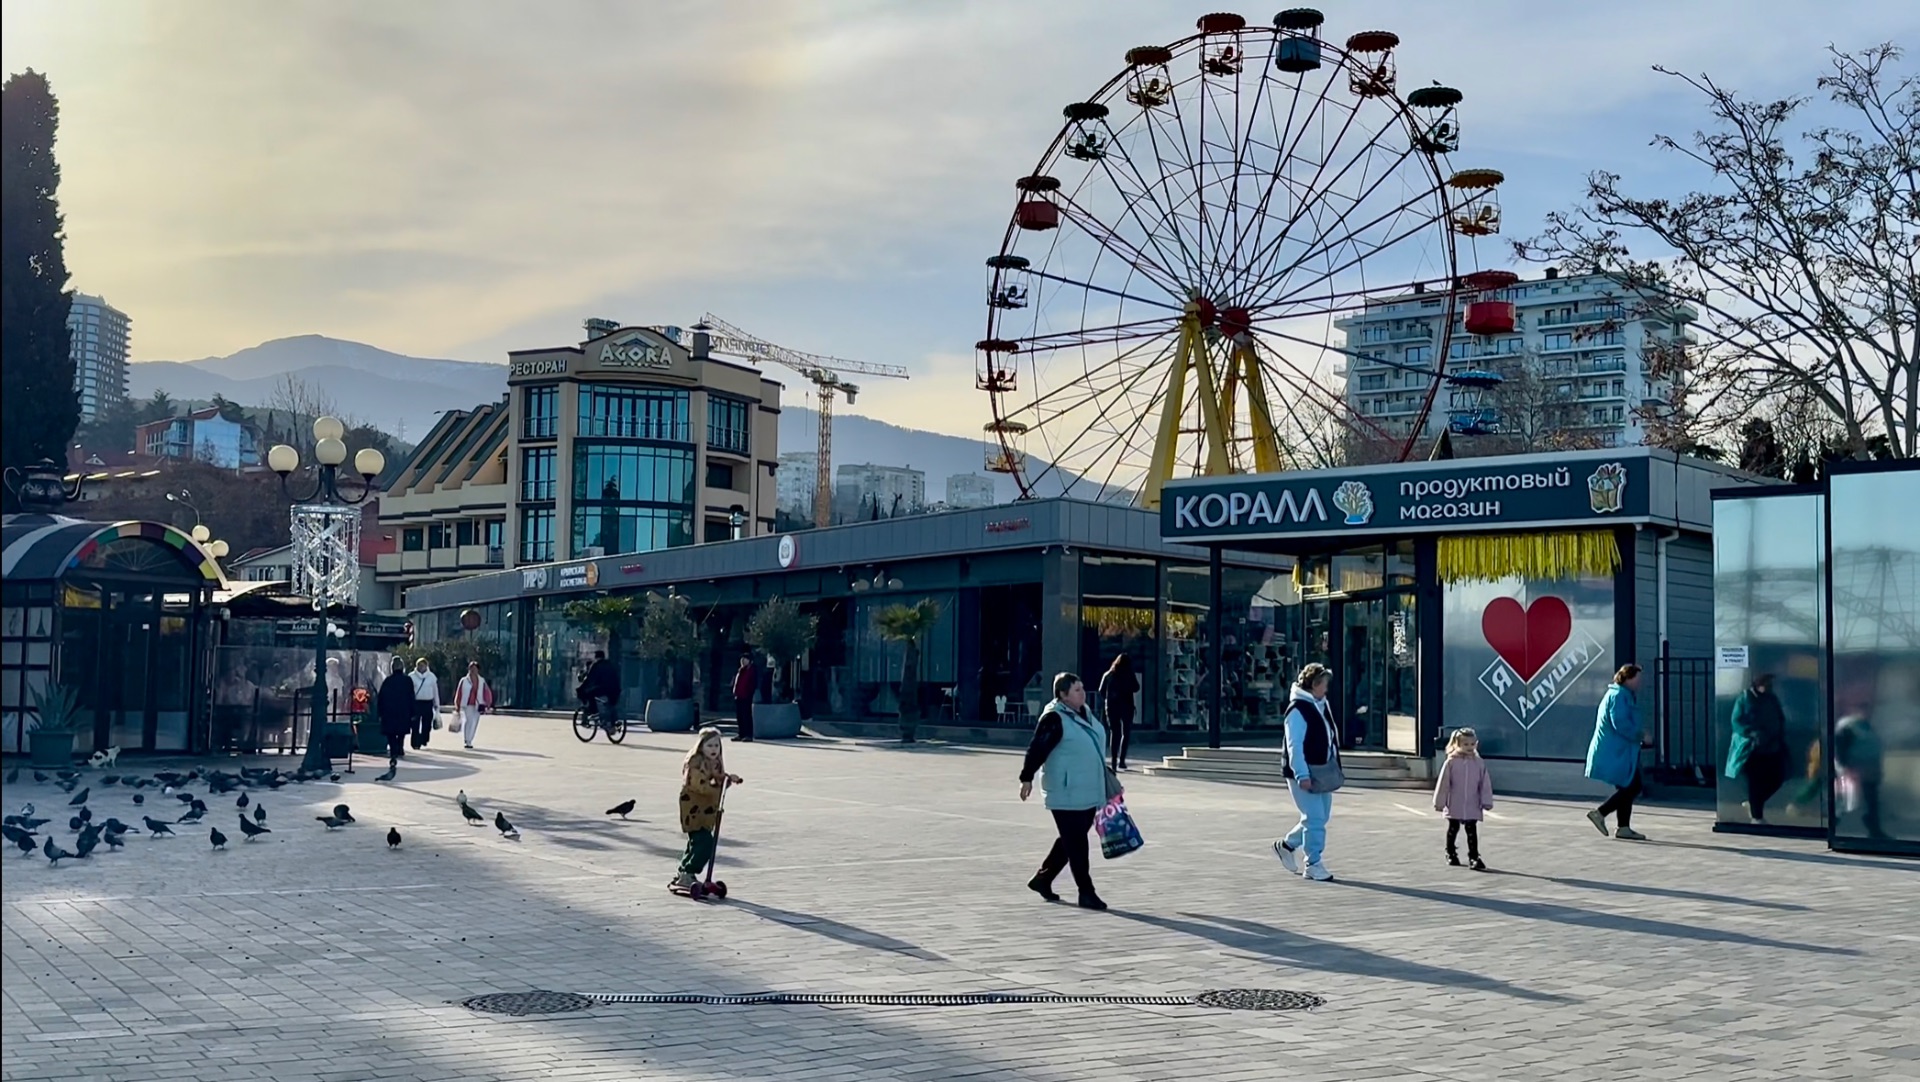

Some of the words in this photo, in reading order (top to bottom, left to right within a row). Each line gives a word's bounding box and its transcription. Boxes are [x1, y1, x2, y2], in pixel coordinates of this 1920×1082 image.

[509, 359, 567, 377] РЕСТОРАН
[599, 344, 673, 365] AGORA
[1399, 466, 1571, 501] продуктовый
[1174, 487, 1327, 529] КОРАЛЛ
[1399, 498, 1501, 521] магазин
[1491, 664, 1514, 697] Я
[1517, 640, 1590, 719] Алушту
